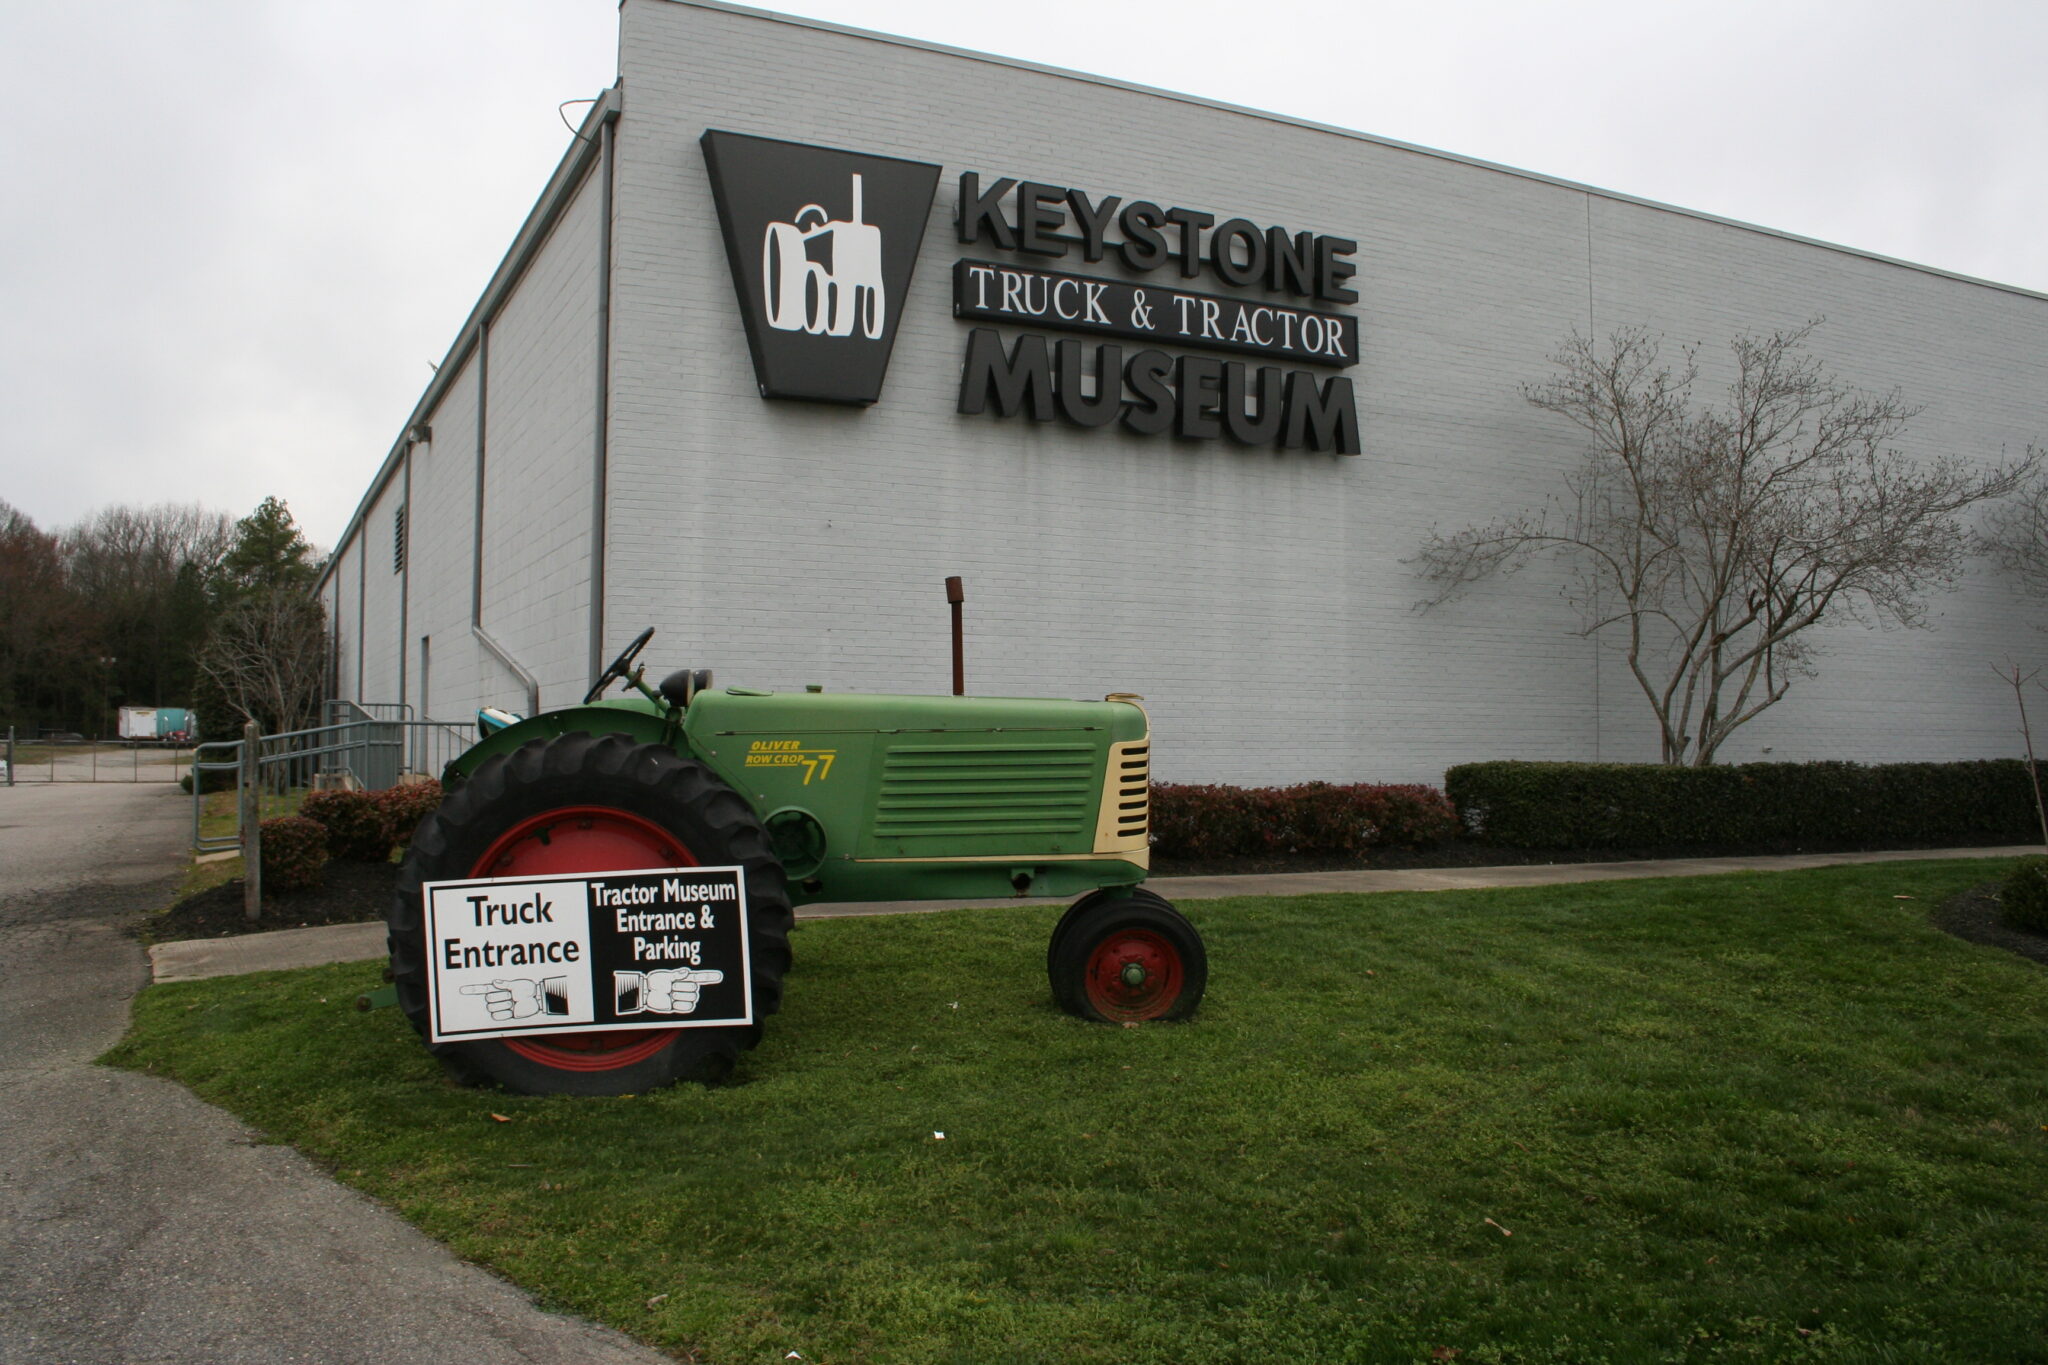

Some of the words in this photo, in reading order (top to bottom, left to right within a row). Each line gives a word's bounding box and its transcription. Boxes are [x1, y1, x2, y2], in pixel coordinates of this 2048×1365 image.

[958, 171, 1358, 304] KEYSTONE
[969, 267, 1112, 325] TRUCK
[1131, 289, 1155, 331] &
[1173, 295, 1347, 357] TRACTOR
[957, 328, 1361, 455] MUSEUM
[746, 754, 772, 764] ROW
[774, 754, 805, 764] CROP
[751, 740, 800, 750] OLIVER
[801, 754, 836, 786] 77
[591, 882, 658, 907] Tractor
[663, 878, 736, 903] Museum
[466, 892, 554, 927] Truck
[616, 908, 696, 934] Entrance
[700, 904, 715, 929] &
[444, 938, 580, 970] Entrance
[634, 935, 701, 966] Parking
